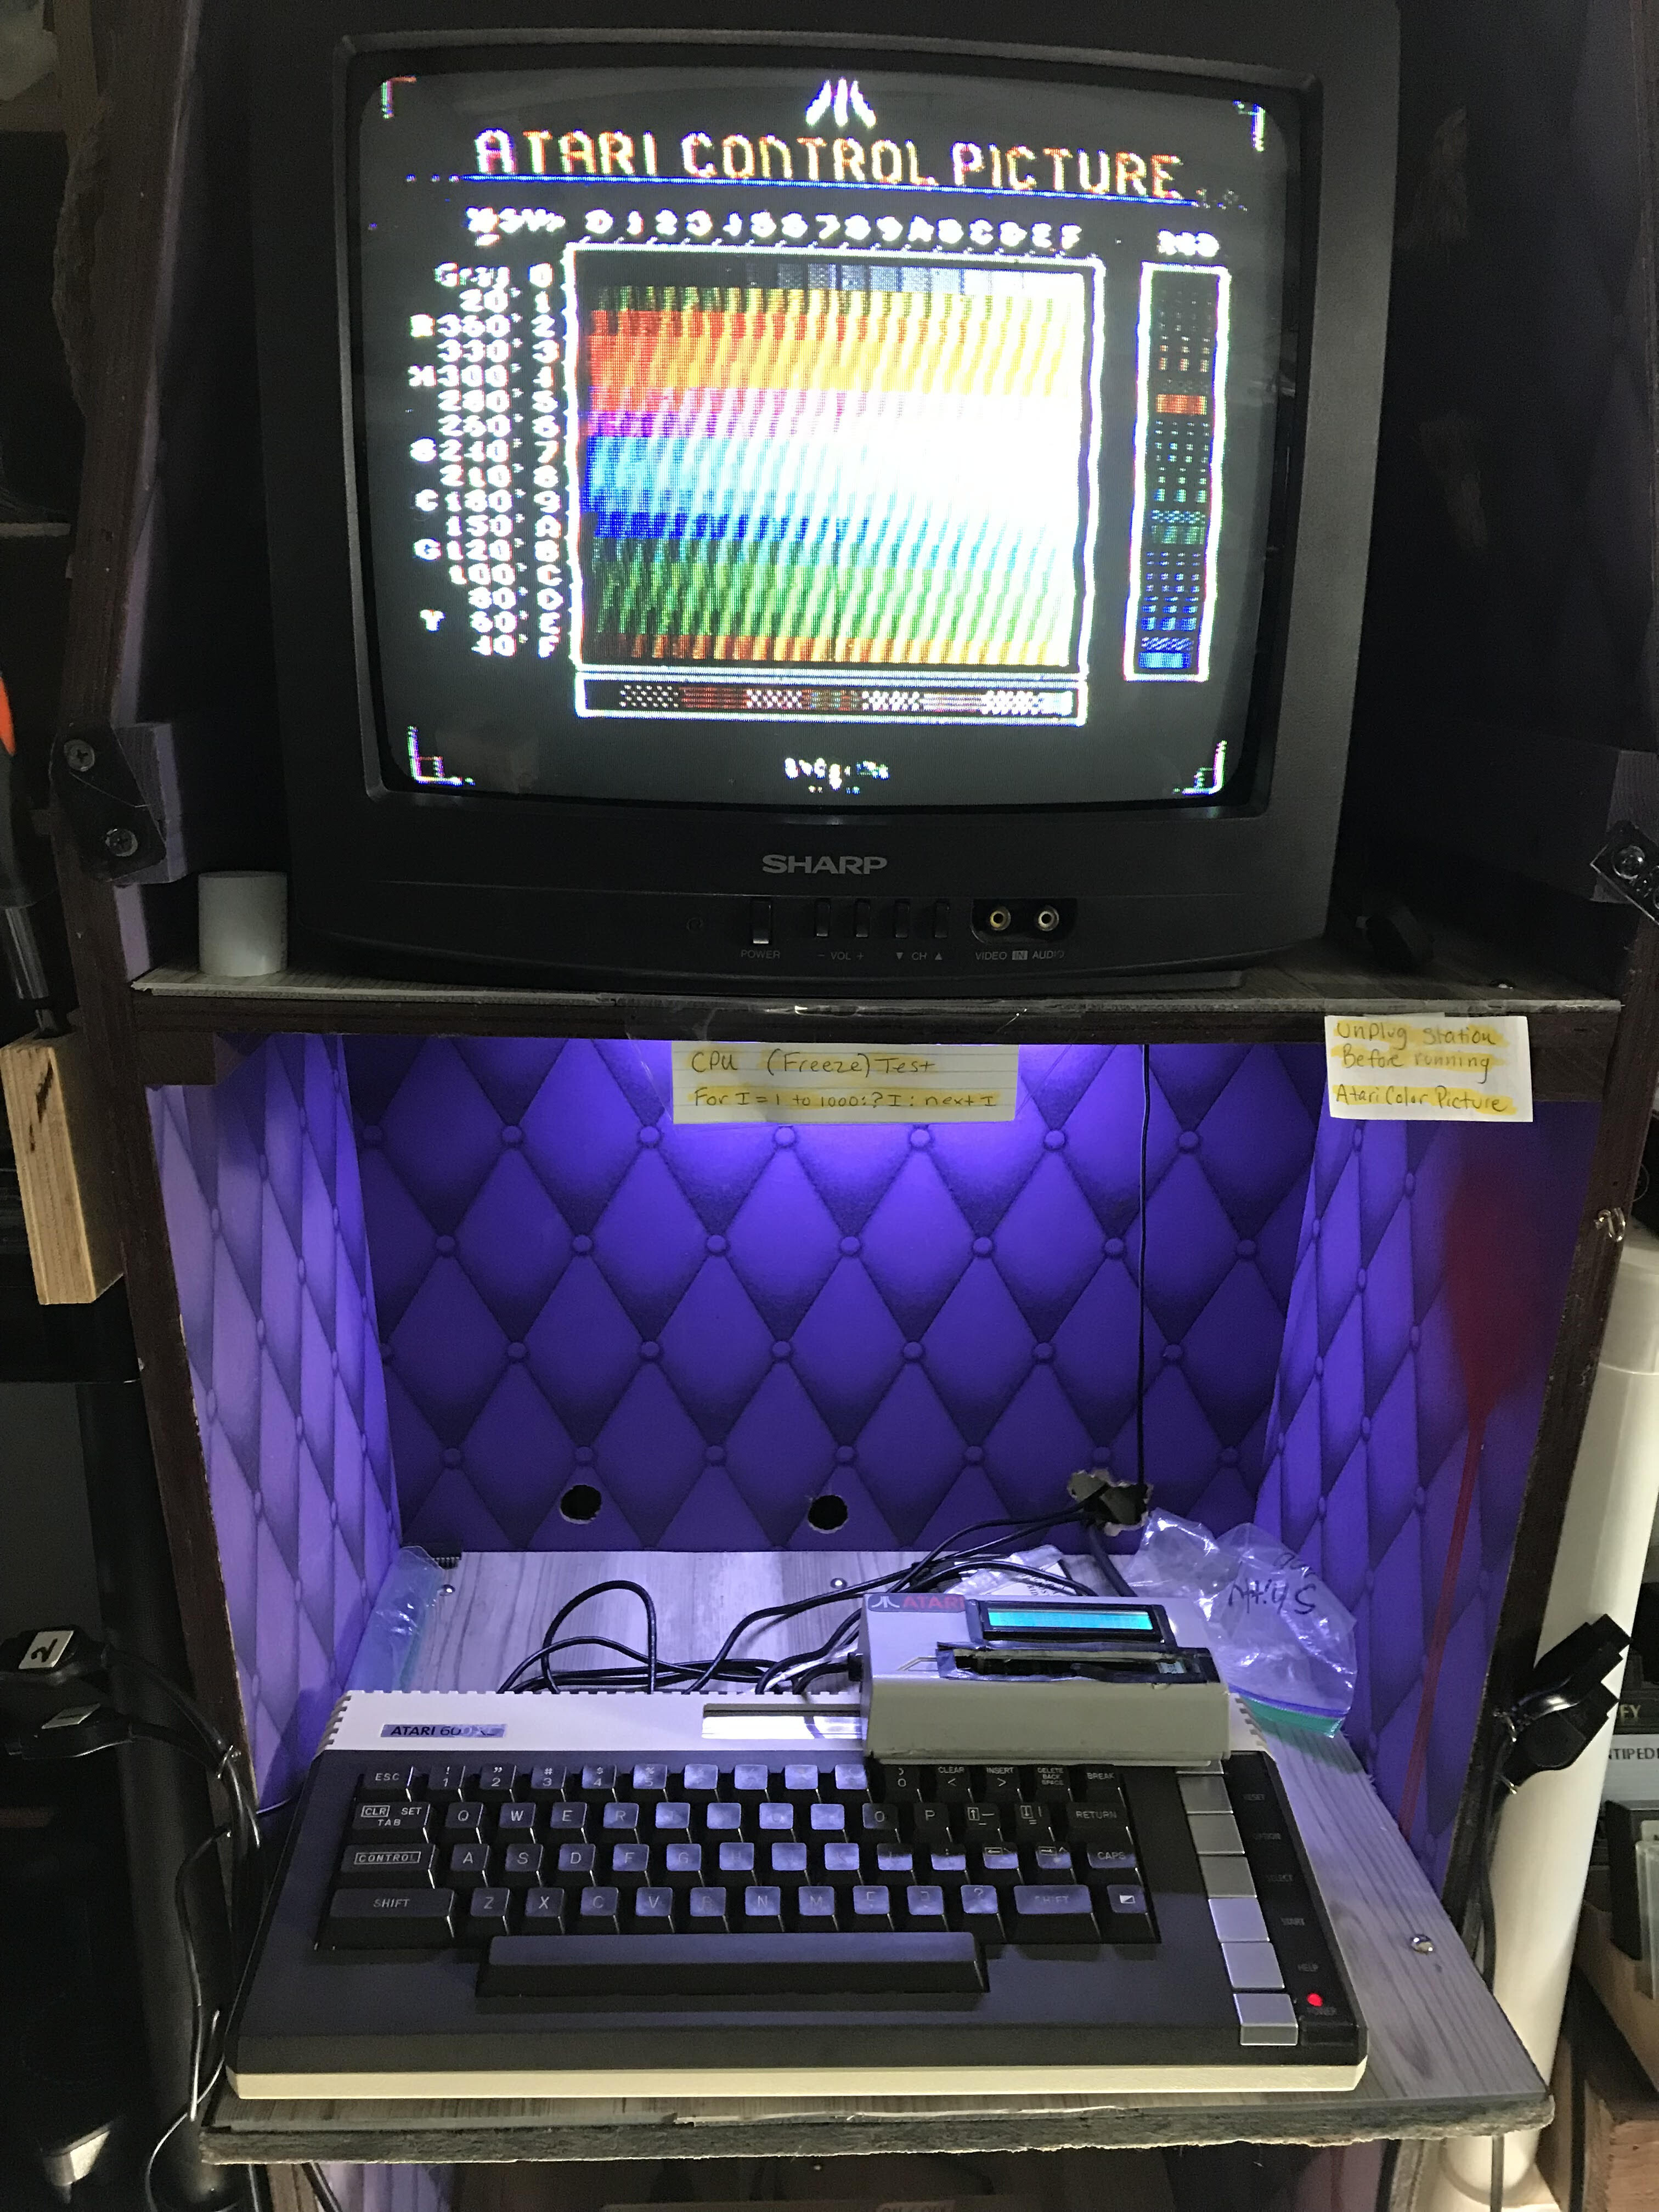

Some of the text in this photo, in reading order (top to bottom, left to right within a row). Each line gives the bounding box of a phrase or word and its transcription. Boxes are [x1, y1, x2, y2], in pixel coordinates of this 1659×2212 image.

[474, 127, 1183, 199] ATARI CONTROL PICTURE
[761, 854, 888, 875] SHARP
[741, 950, 781, 959] POWER
[830, 952, 851, 961] VOL
[911, 952, 927, 961] CH
[975, 951, 1007, 961] VIDEO
[767, 1048, 871, 1079] (Freeze)
[875, 1058, 935, 1074] Test
[1342, 1043, 1491, 1084] Before running
[694, 1087, 729, 1107] For
[795, 1094, 811, 1106] to
[925, 1094, 974, 1107] next
[1336, 1084, 1508, 1112] Atari Color Picture
[902, 1595, 965, 1609] ATARI
[391, 1726, 435, 1736] ATARI
[375, 1773, 399, 1781] ESC
[1087, 1772, 1115, 1780] BREAK
[492, 1778, 500, 1787] 2
[543, 1778, 552, 1787] 3
[593, 1778, 601, 1787] 4
[365, 1807, 421, 1815] CLR SET
[458, 1810, 469, 1822] Q
[510, 1810, 523, 1821] W
[562, 1810, 573, 1821] E
[616, 1810, 626, 1821] R
[925, 1811, 935, 1821] P
[1076, 1811, 1117, 1819] RETURN
[358, 1853, 416, 1863] CONTROL
[462, 1853, 473, 1863] A
[517, 1853, 528, 1864] S
[571, 1853, 582, 1863] D
[1097, 1852, 1126, 1860] CAPS
[373, 1899, 410, 1908] SHIFT
[483, 1897, 493, 1909] Z
[538, 1897, 549, 1909] X
[592, 1897, 603, 1908] C
[648, 1895, 659, 1908] V
[758, 1895, 767, 1906] N
[810, 1895, 822, 1906] M
